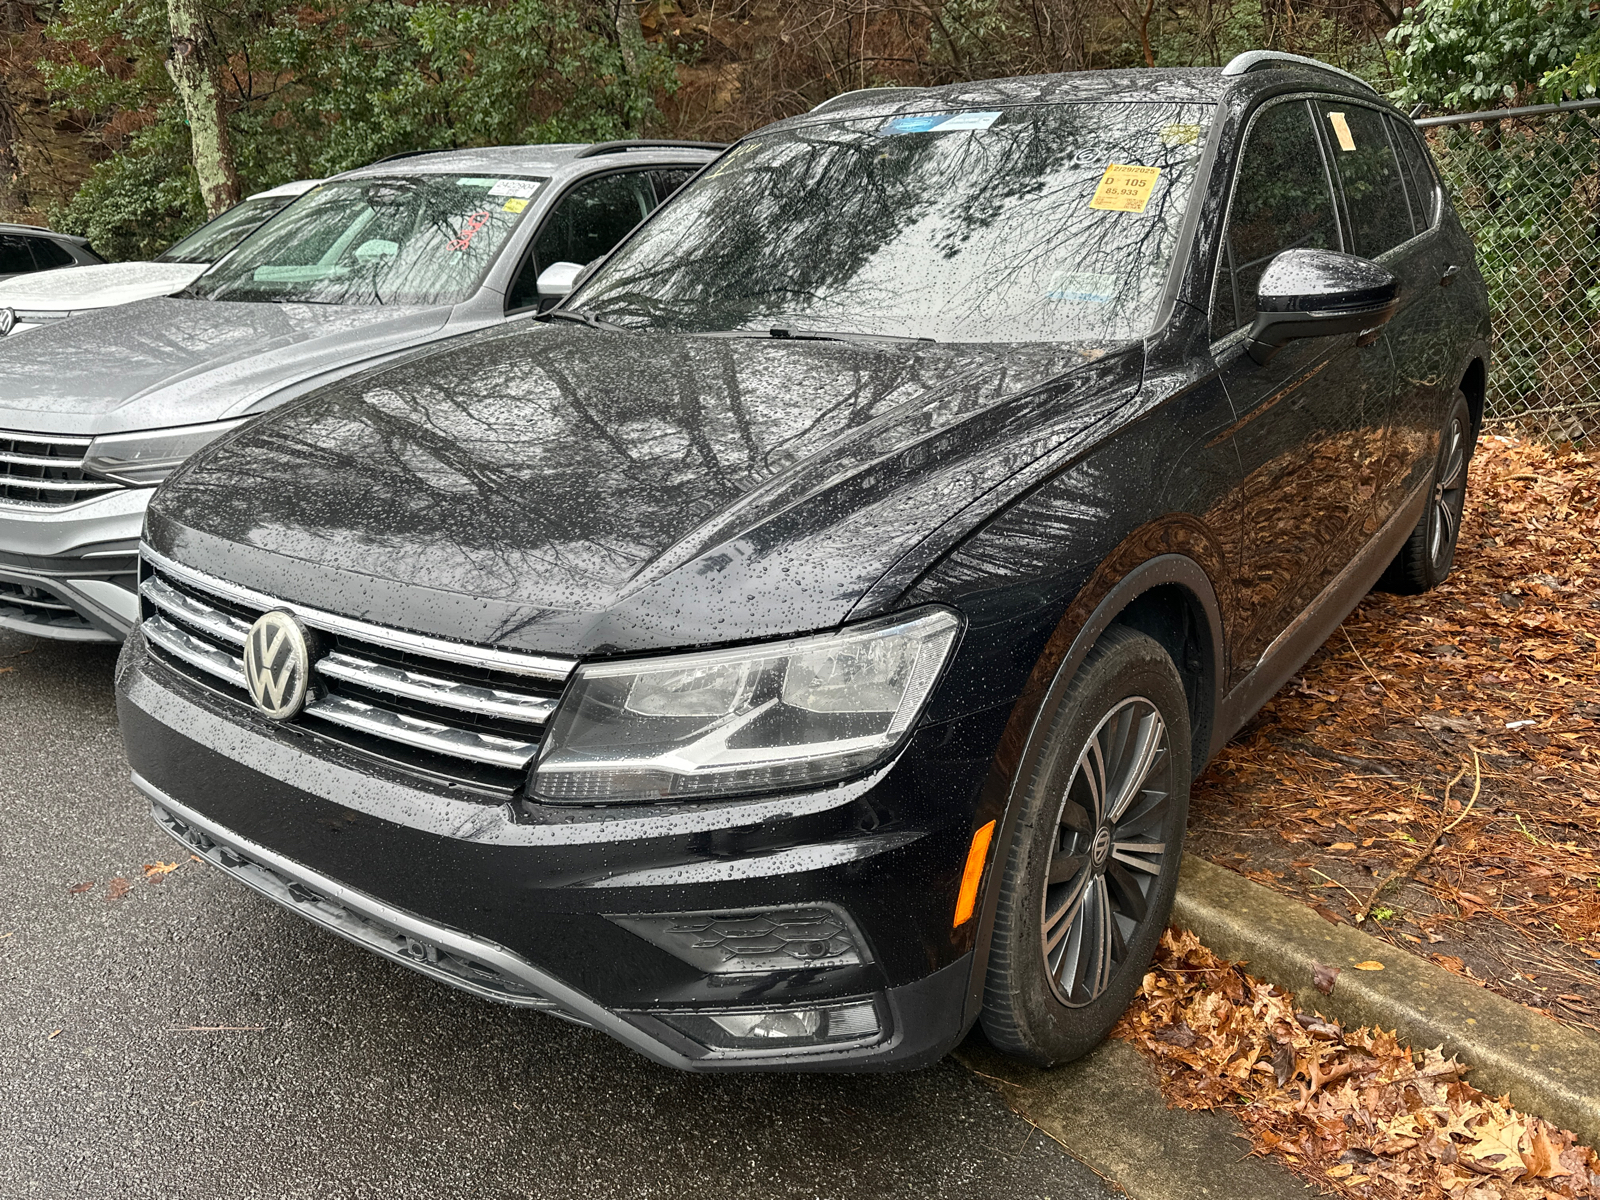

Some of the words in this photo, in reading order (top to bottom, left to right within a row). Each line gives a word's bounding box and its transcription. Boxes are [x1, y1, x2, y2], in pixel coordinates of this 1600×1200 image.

[1112, 166, 1156, 175] 2/29/2025
[1105, 177, 1115, 185] D
[1125, 178, 1147, 187] 105
[1105, 187, 1139, 196] 85,933
[245, 614, 305, 716] VW
